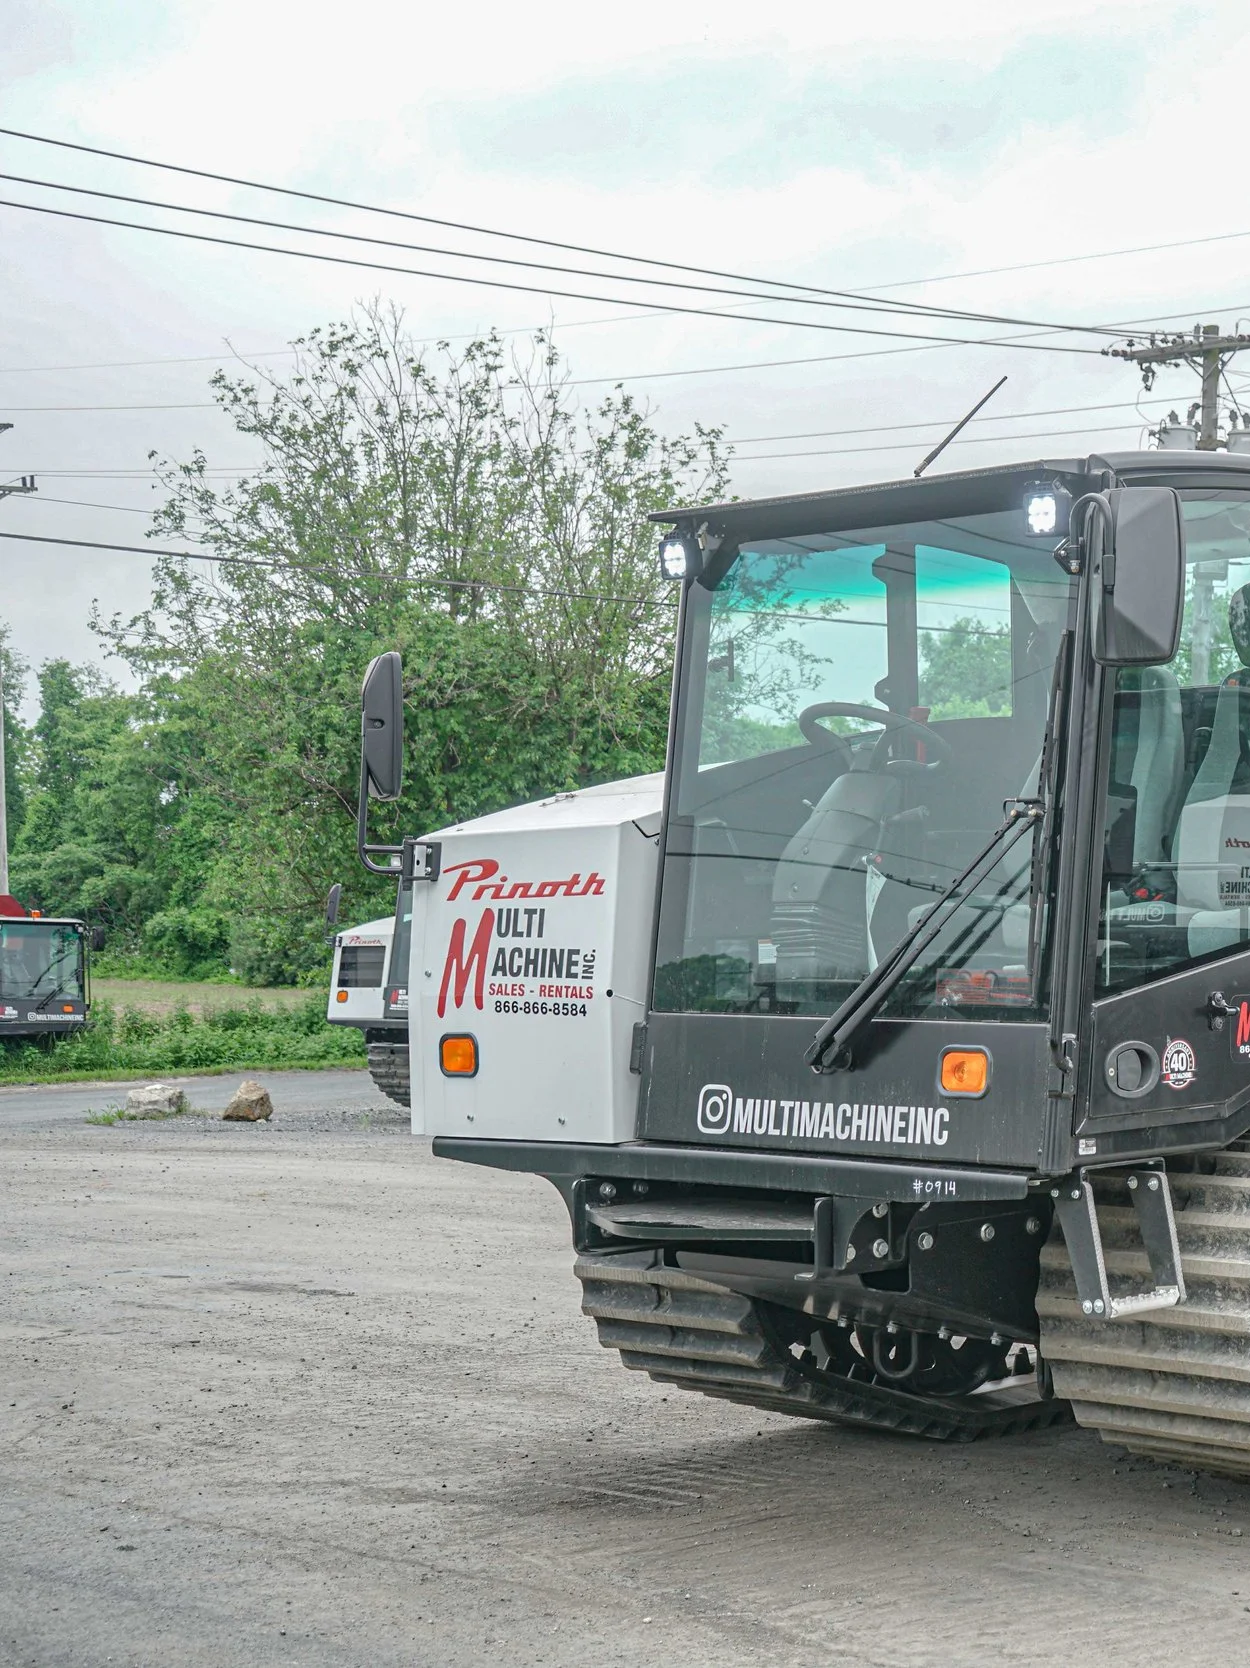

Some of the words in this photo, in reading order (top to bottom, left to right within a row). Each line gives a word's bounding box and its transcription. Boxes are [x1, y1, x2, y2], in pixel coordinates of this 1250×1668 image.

[443, 859, 606, 901] Prinoth
[582, 949, 596, 980] INC.
[489, 983, 525, 997] SALES
[539, 985, 594, 999] RENTALS
[495, 1001, 587, 1017] 866-866-8584
[1170, 1052, 1187, 1072] 40
[732, 1098, 950, 1146] MULTIMACHINEINC
[912, 1180, 956, 1196] #0914
